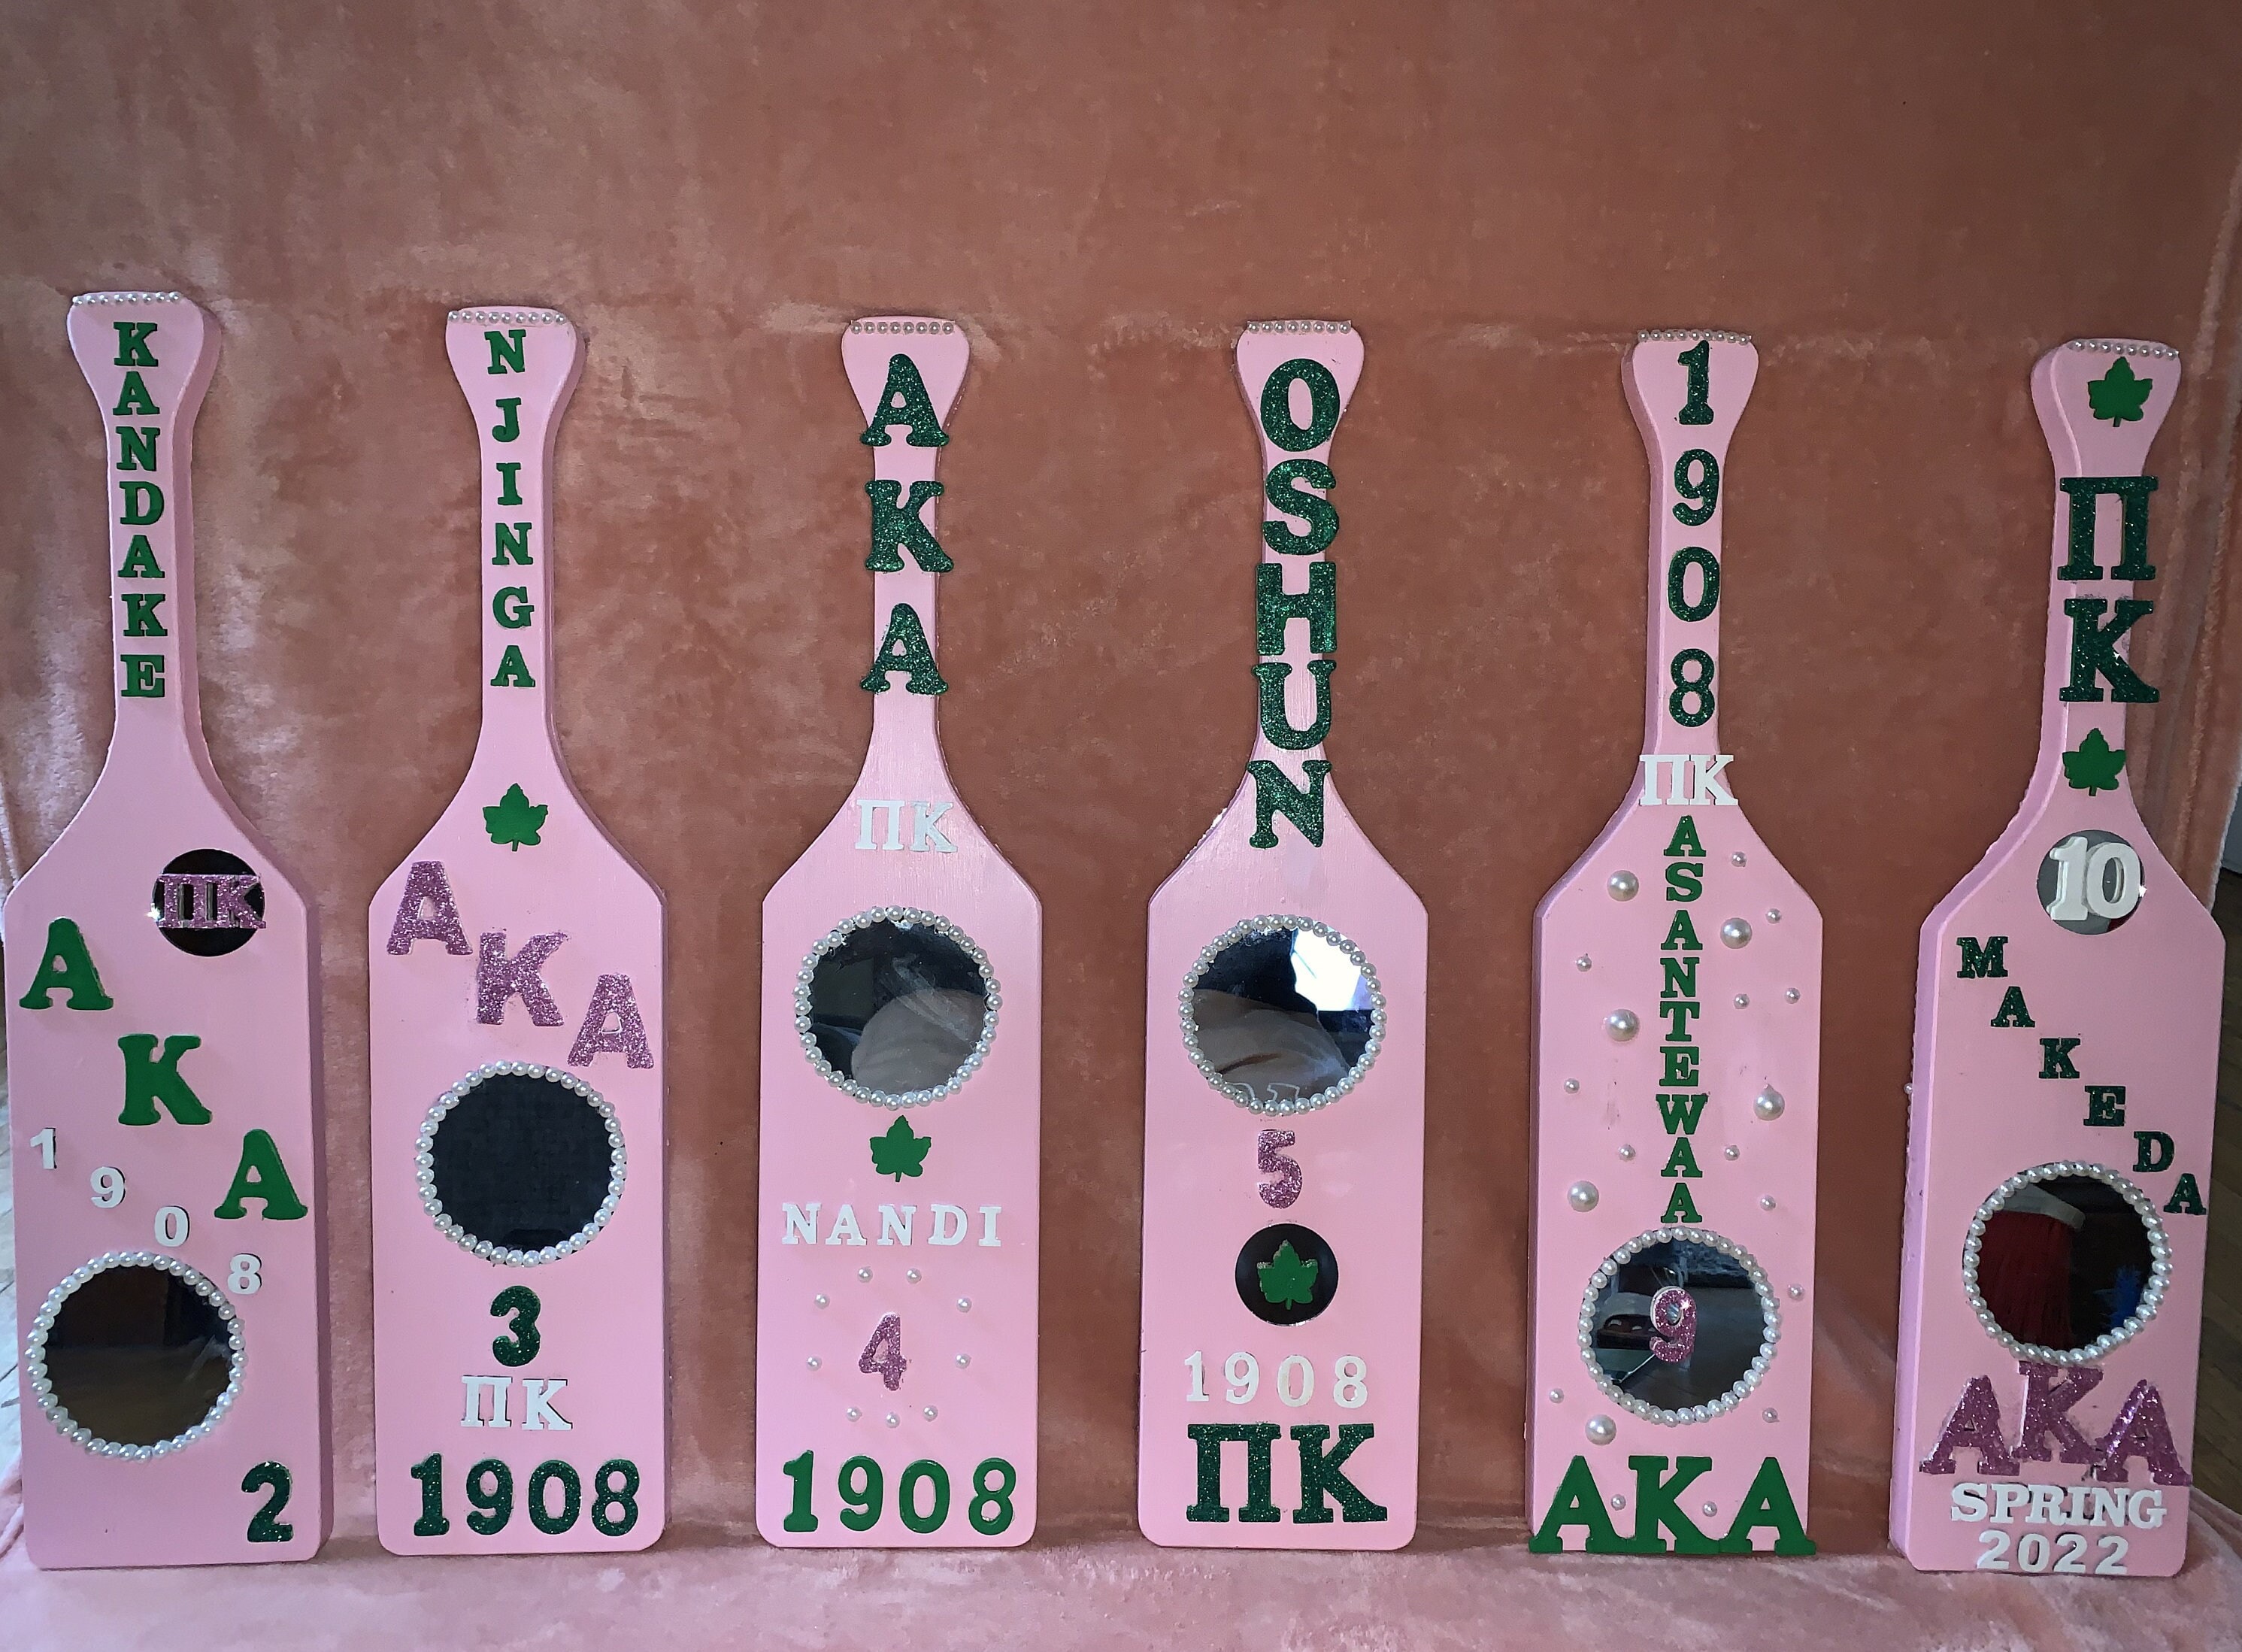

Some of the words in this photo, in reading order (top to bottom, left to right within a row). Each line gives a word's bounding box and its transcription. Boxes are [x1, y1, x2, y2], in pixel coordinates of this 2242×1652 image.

[113, 322, 168, 698] KANDAKE
[484, 329, 535, 687] NJINGA
[859, 353, 954, 696] AKA
[1667, 340, 1720, 728] 1908
[1247, 358, 1341, 849] OSHUN
[2047, 835, 2143, 920] 10
[386, 861, 654, 1068] AKA
[1256, 1129, 1303, 1209] 5
[781, 1202, 1002, 1247] NANDI
[489, 1285, 542, 1367] 3
[859, 1314, 906, 1391] 4
[1650, 1286, 1697, 1362] 9
[1184, 1351, 1368, 1408] 1908
[1919, 1360, 2194, 1487] AKA
[241, 1462, 294, 1543] 2
[411, 1453, 641, 1538] 1908
[783, 1450, 1016, 1534] 1908
[1528, 1455, 1816, 1554] AKA
[1951, 1482, 2167, 1529] SPRING
[1977, 1529, 2128, 1575] 2022
